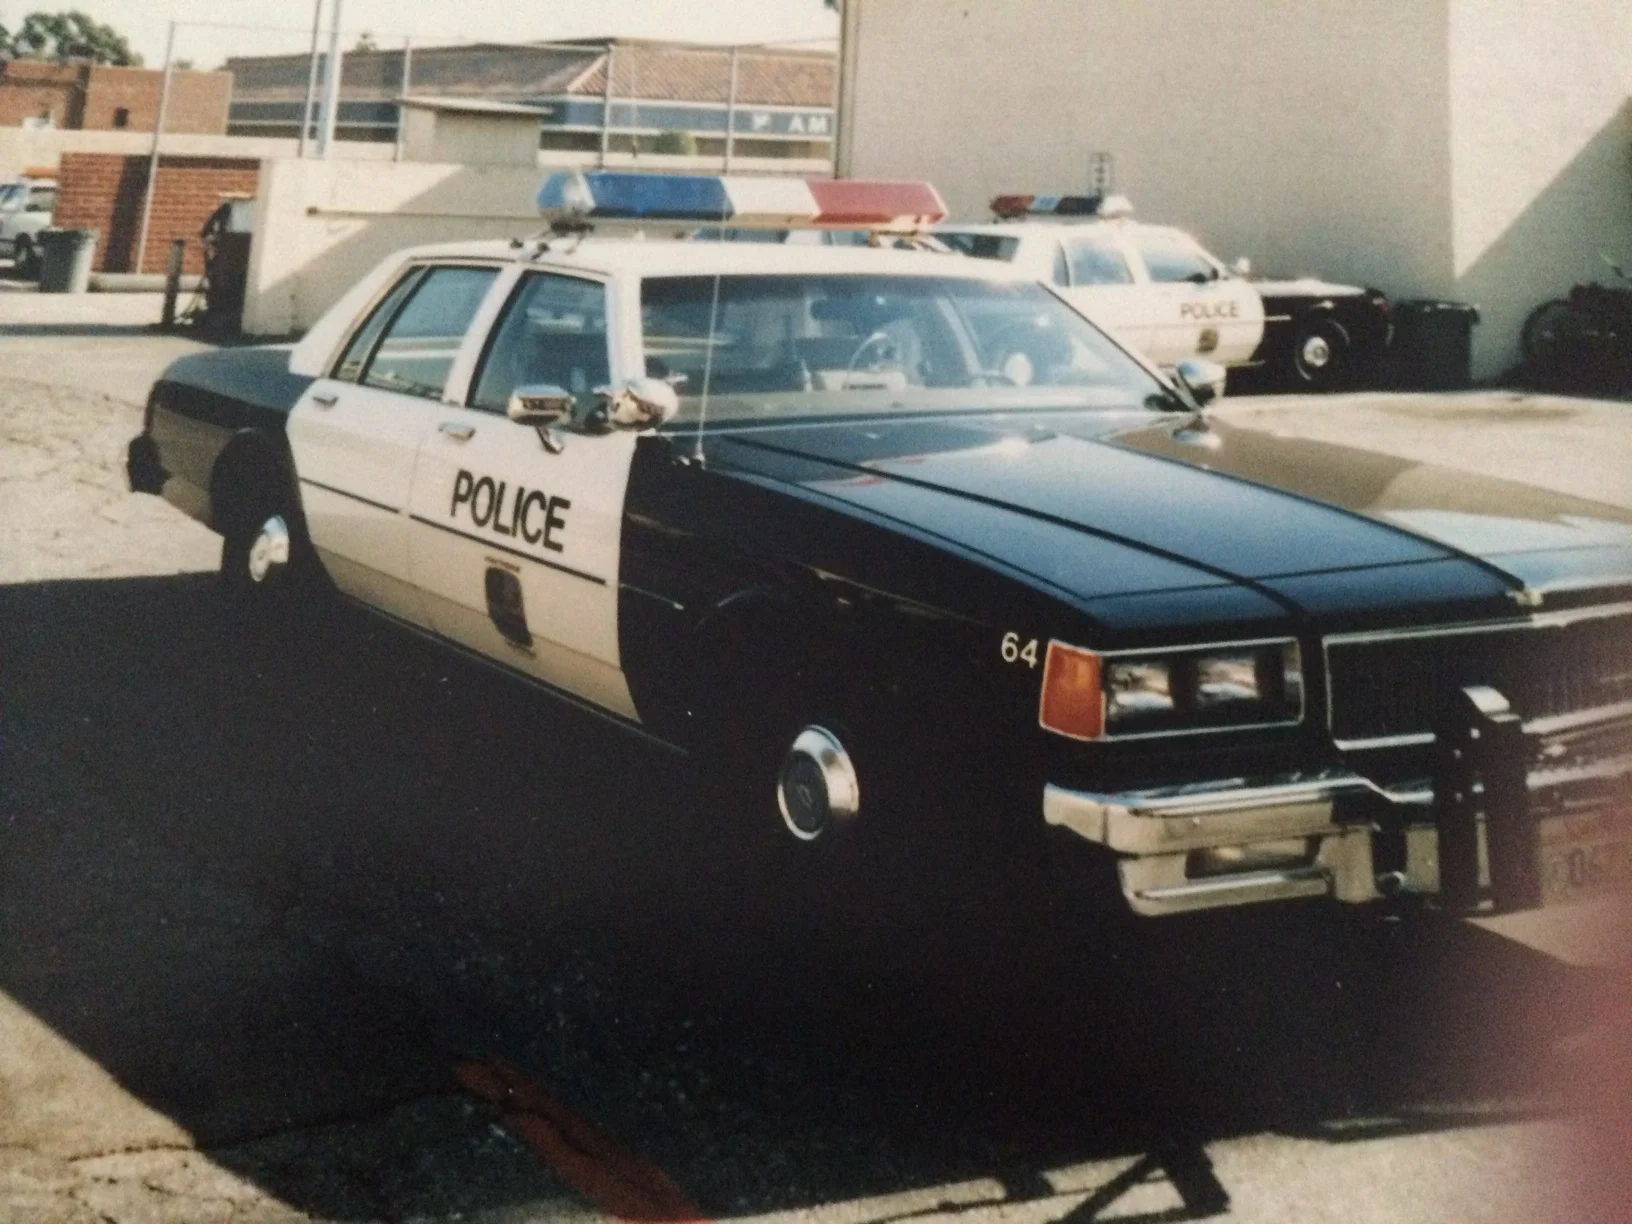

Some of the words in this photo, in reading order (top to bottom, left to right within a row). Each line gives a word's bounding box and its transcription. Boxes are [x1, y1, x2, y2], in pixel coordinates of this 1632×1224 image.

[1180, 301, 1239, 320] POLICE
[450, 469, 571, 553] POLICE
[1001, 632, 1038, 669] 64
